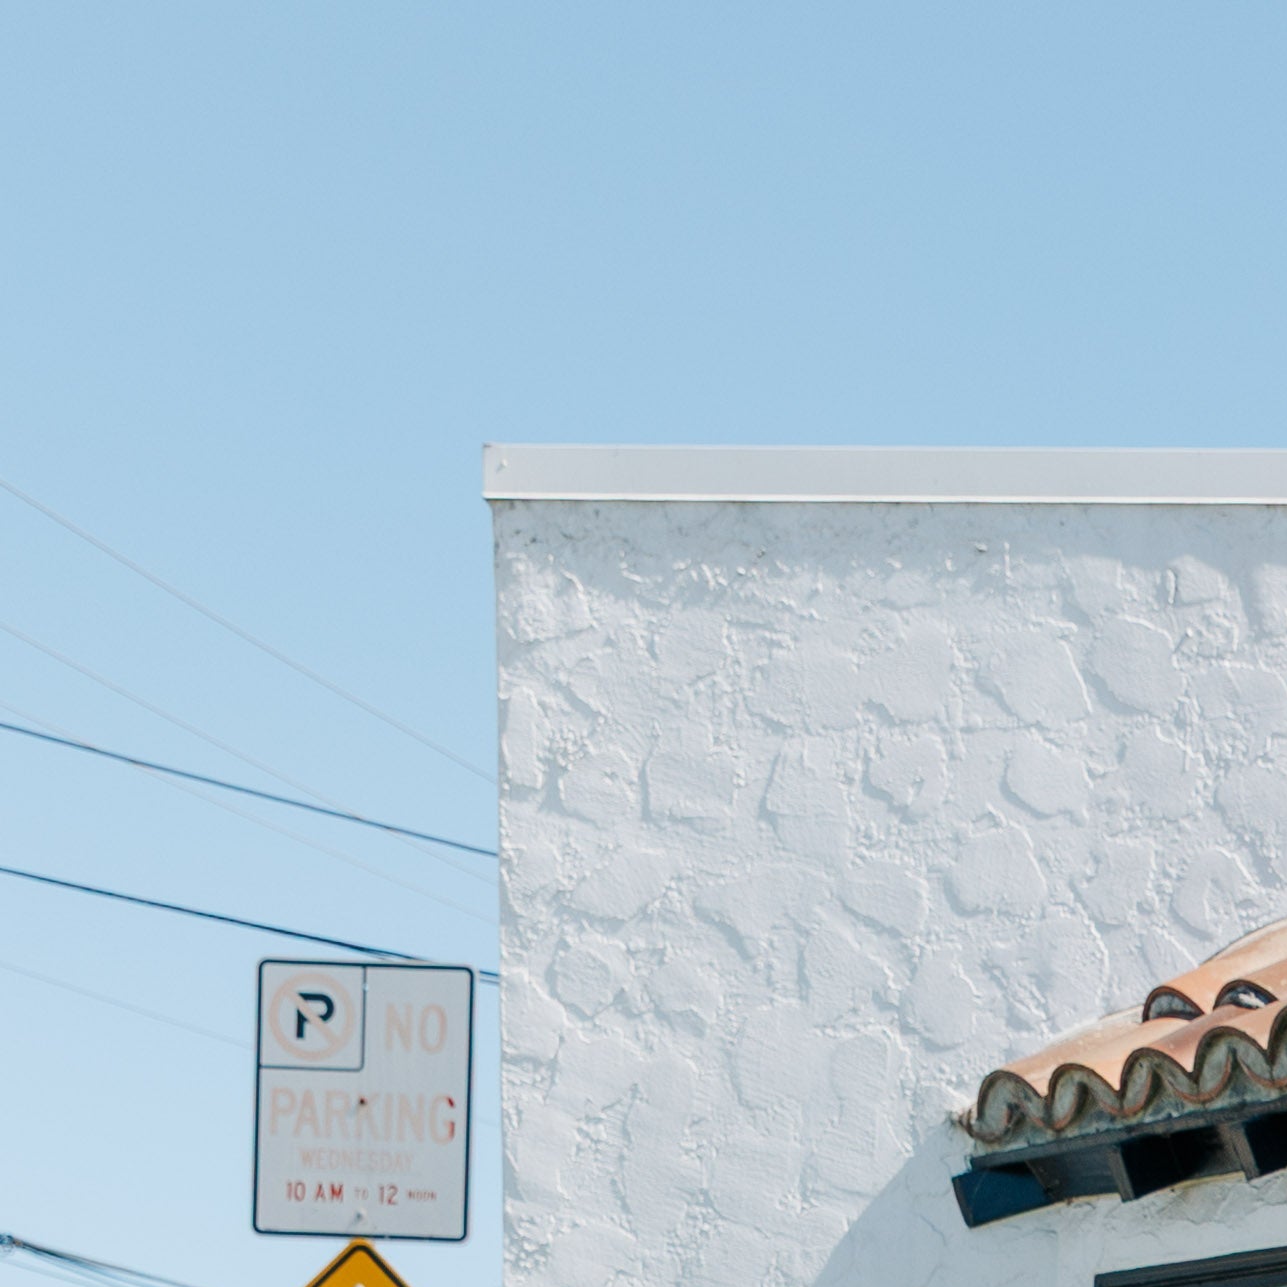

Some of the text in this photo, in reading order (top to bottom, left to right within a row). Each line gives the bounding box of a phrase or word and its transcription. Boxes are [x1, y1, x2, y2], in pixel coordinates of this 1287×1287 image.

[385, 1002, 448, 1055] NO
[268, 1087, 456, 1146] PARKING
[298, 1147, 415, 1173] WEDNESDAY
[285, 1180, 307, 1202] 10
[314, 1182, 344, 1204] AM
[378, 1184, 399, 1206] 12
